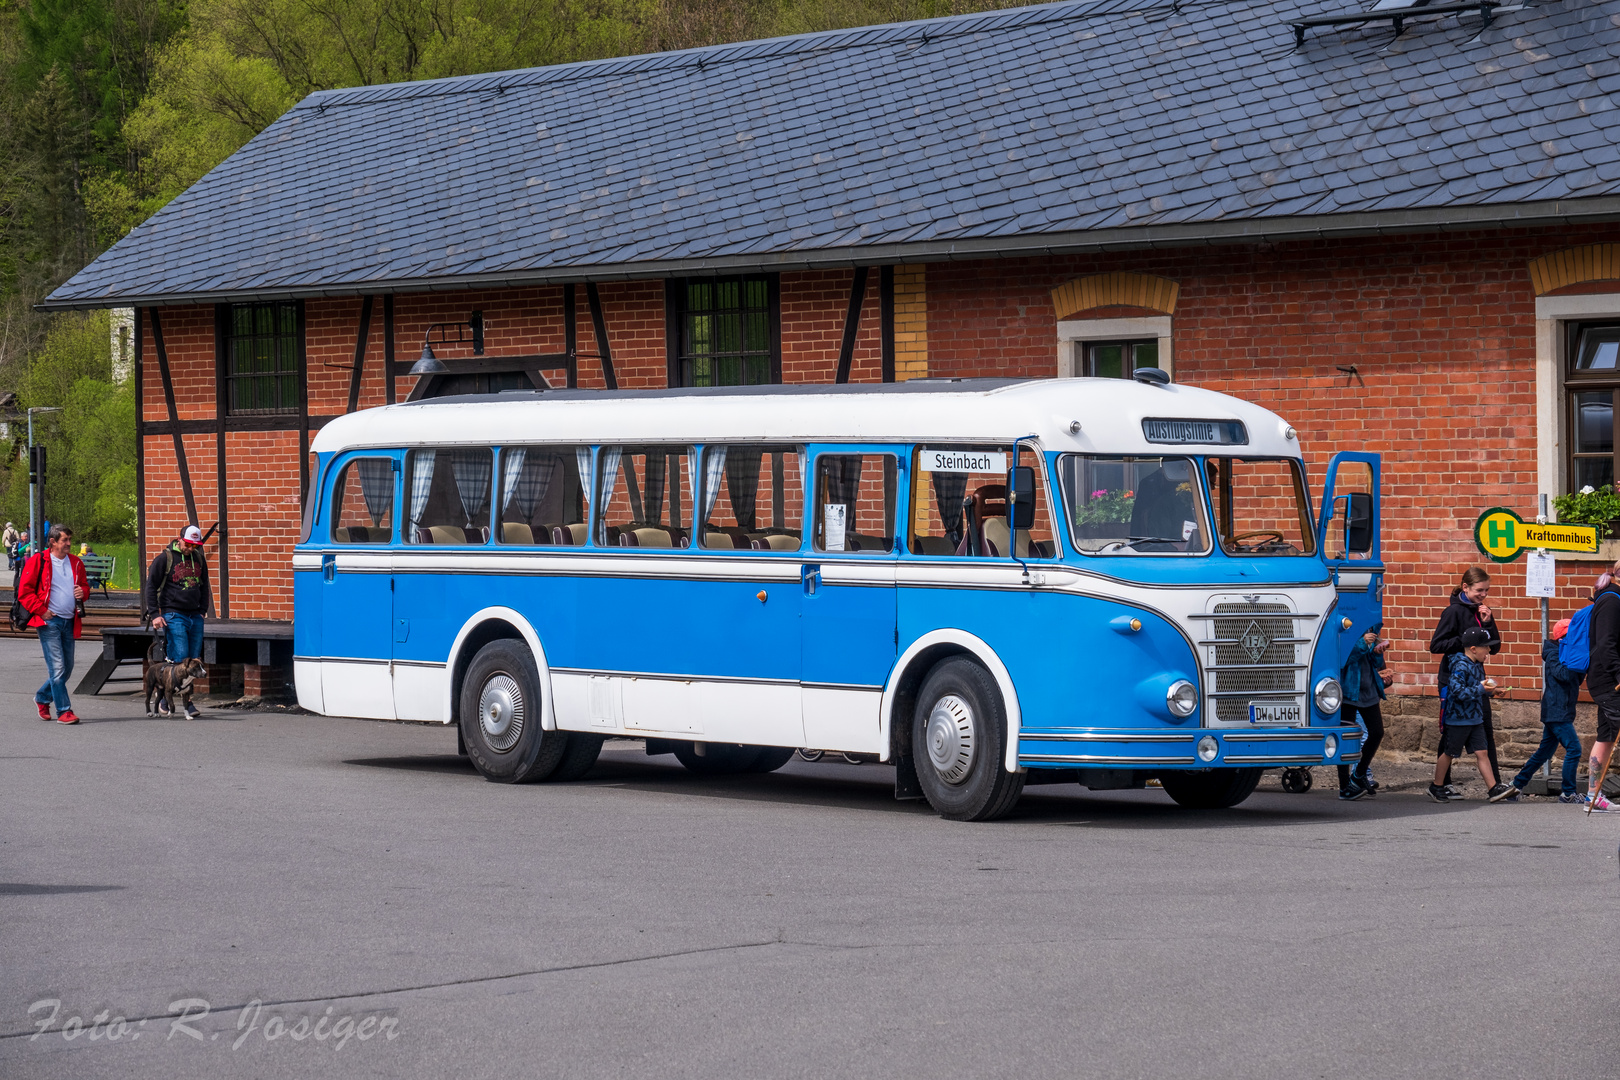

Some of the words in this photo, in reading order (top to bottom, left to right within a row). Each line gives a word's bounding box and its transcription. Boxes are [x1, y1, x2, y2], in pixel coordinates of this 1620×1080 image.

[1148, 420, 1213, 441] Ausflugslinie
[935, 452, 991, 470] Steinbach
[1488, 520, 1515, 548] H
[1526, 529, 1592, 544] Kraftomnibus
[1255, 707, 1268, 720] DW
[1273, 707, 1300, 721] LH6H
